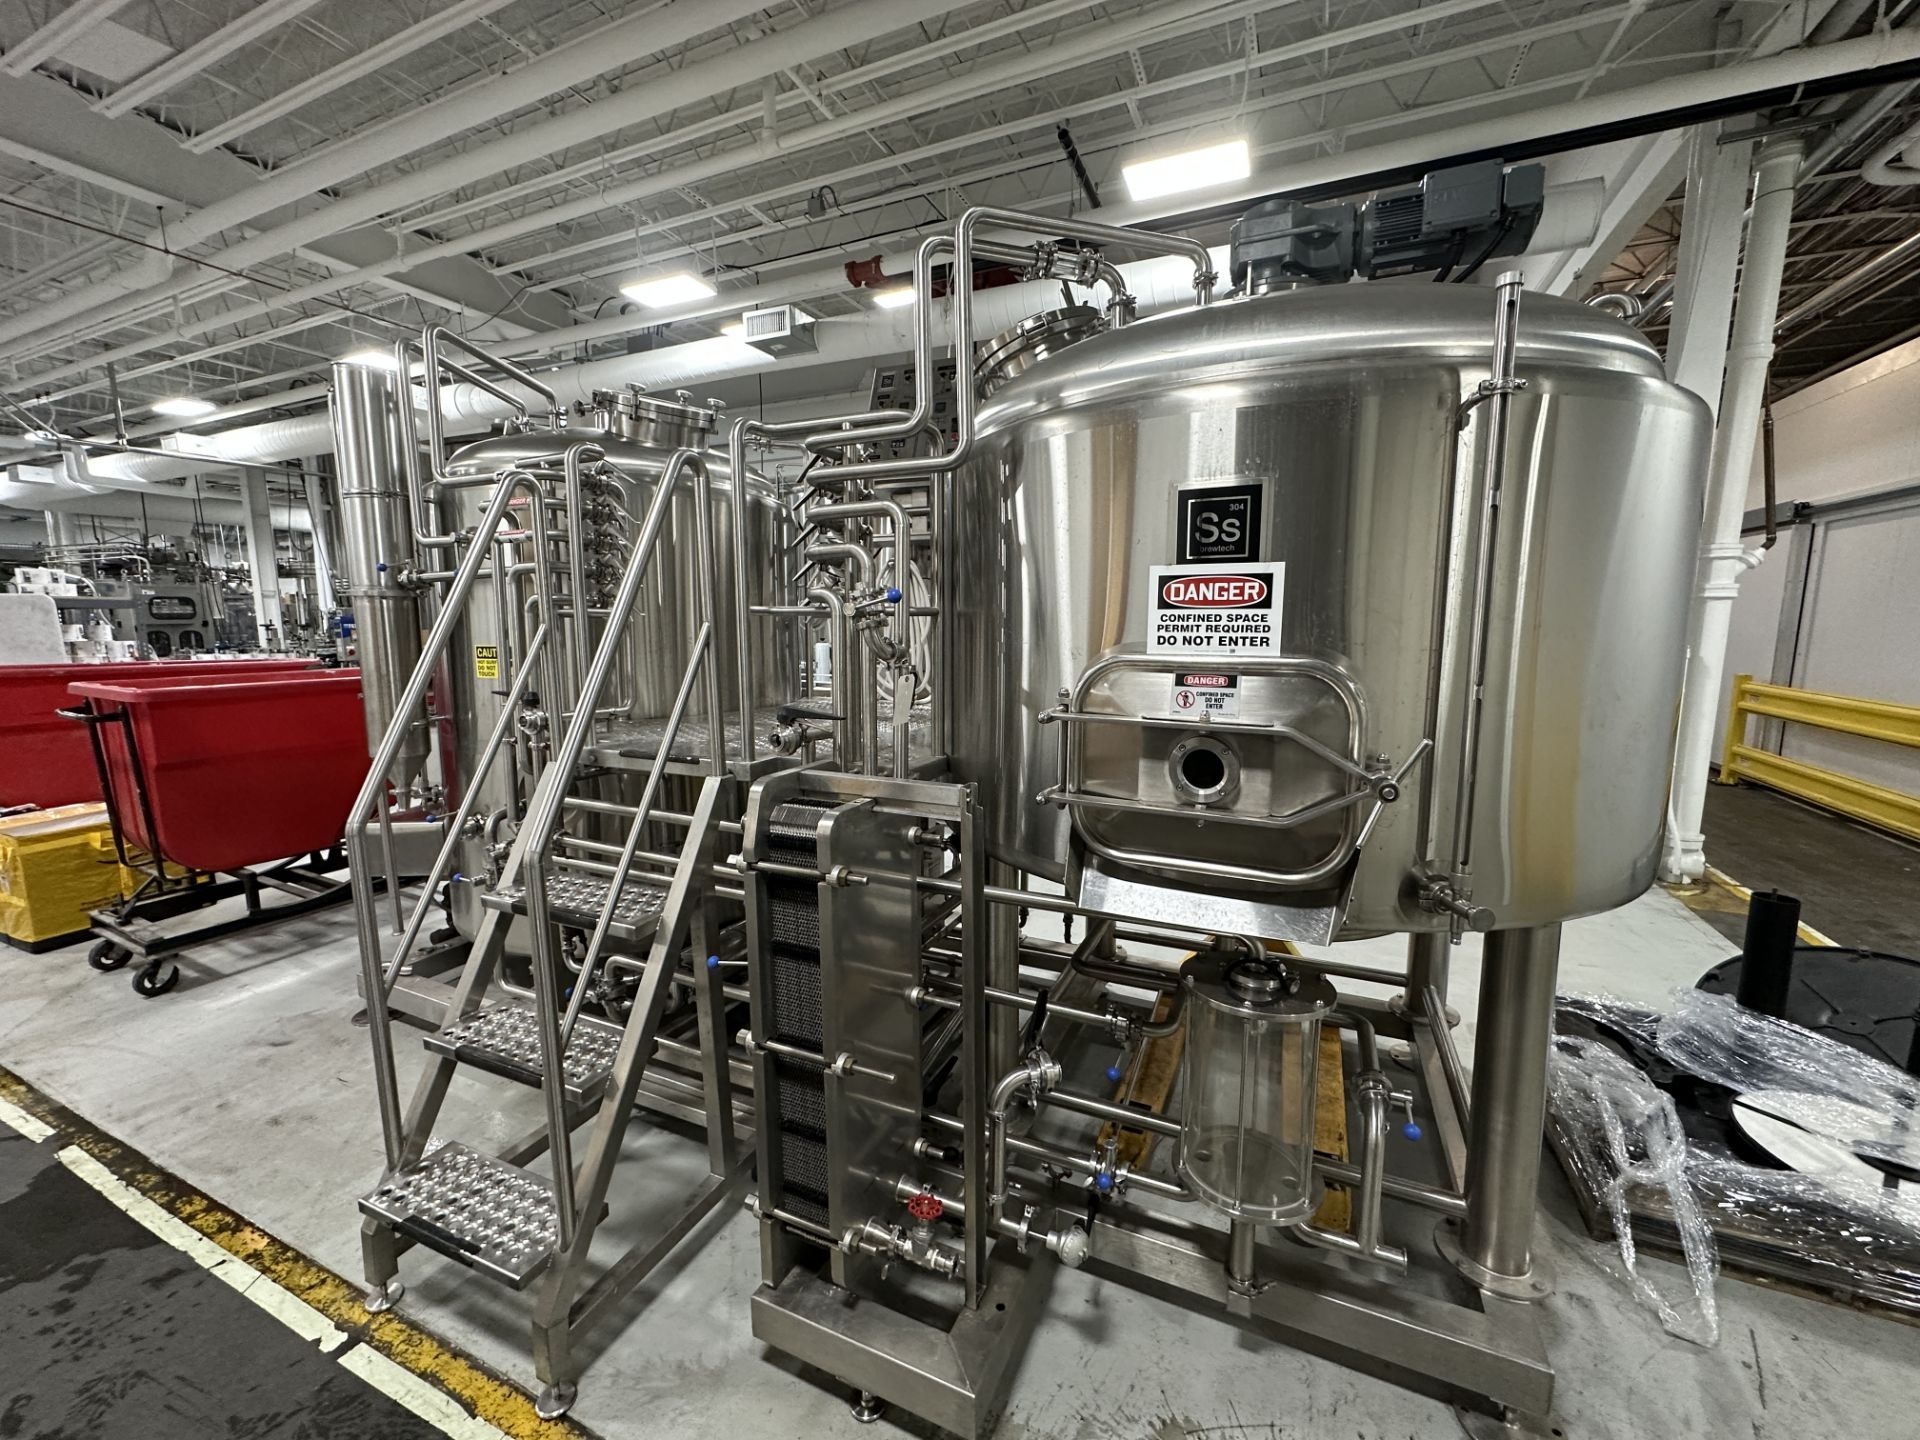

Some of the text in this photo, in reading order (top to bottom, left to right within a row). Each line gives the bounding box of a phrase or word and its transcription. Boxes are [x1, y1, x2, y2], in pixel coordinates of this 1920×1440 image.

[1229, 503, 1244, 511] 304
[1195, 512, 1240, 543] Ss
[1170, 582, 1260, 600] DANGER
[1160, 614, 1268, 623] CONFINED SPACE
[1157, 624, 1271, 634] PERMIT REQUIRED
[1157, 635, 1270, 647] DO NOT ENTER
[477, 648, 497, 658] CAUT
[1187, 676, 1225, 685] DANGER
